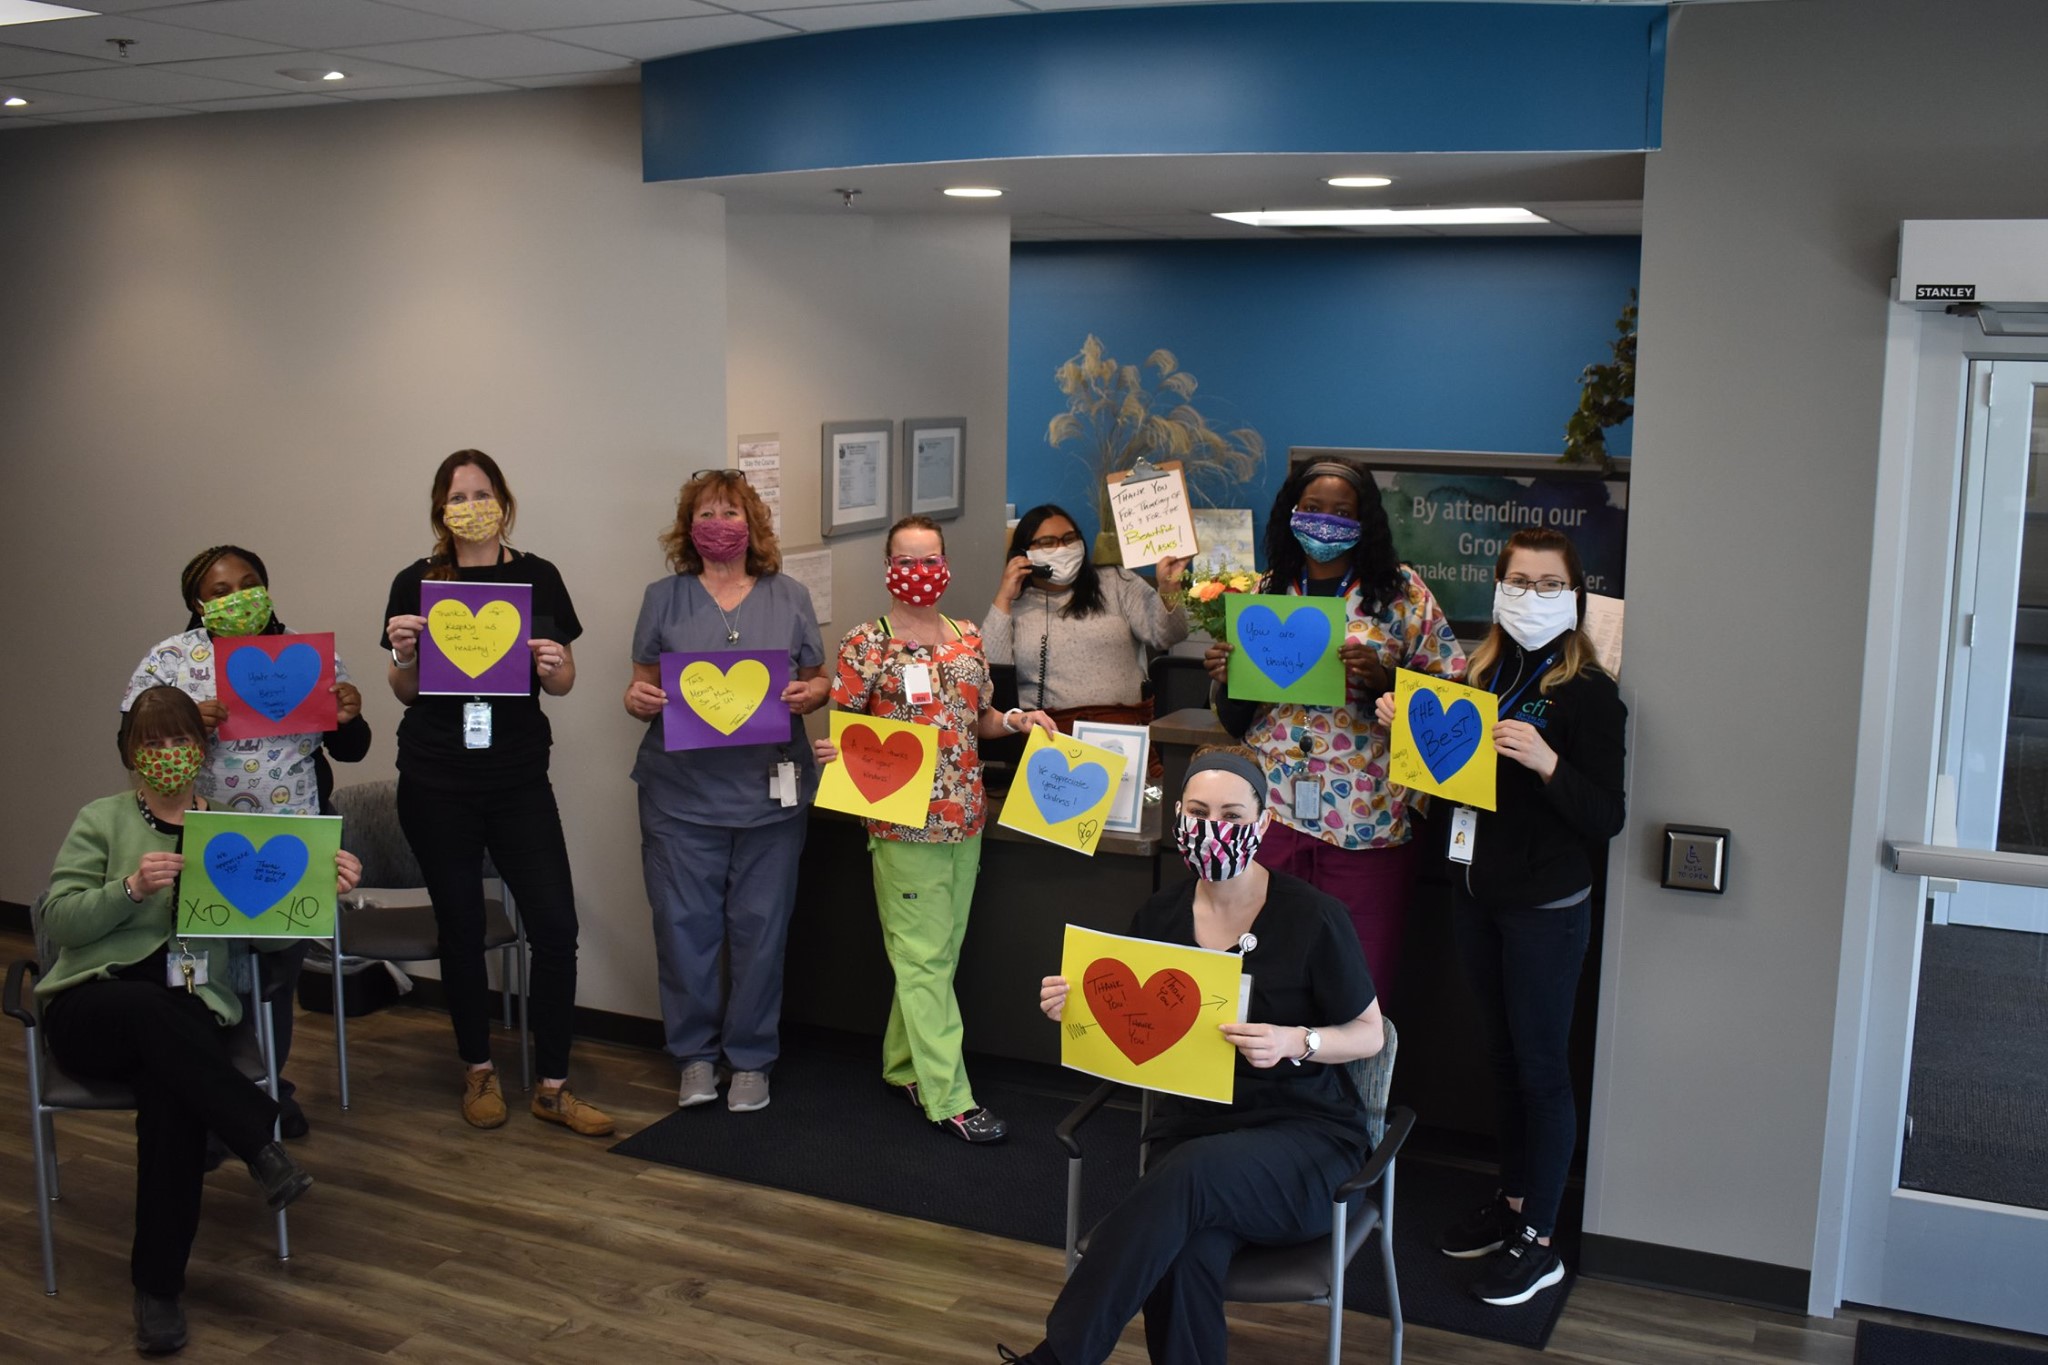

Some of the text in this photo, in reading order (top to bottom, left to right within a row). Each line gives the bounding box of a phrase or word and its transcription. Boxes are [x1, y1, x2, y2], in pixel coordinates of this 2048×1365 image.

[1917, 287, 1973, 297] STANLEY
[1412, 495, 1587, 526] By attending our
[1415, 562, 1488, 583] make the
[1409, 700, 1435, 724] THE
[185, 896, 320, 931] XO XO
